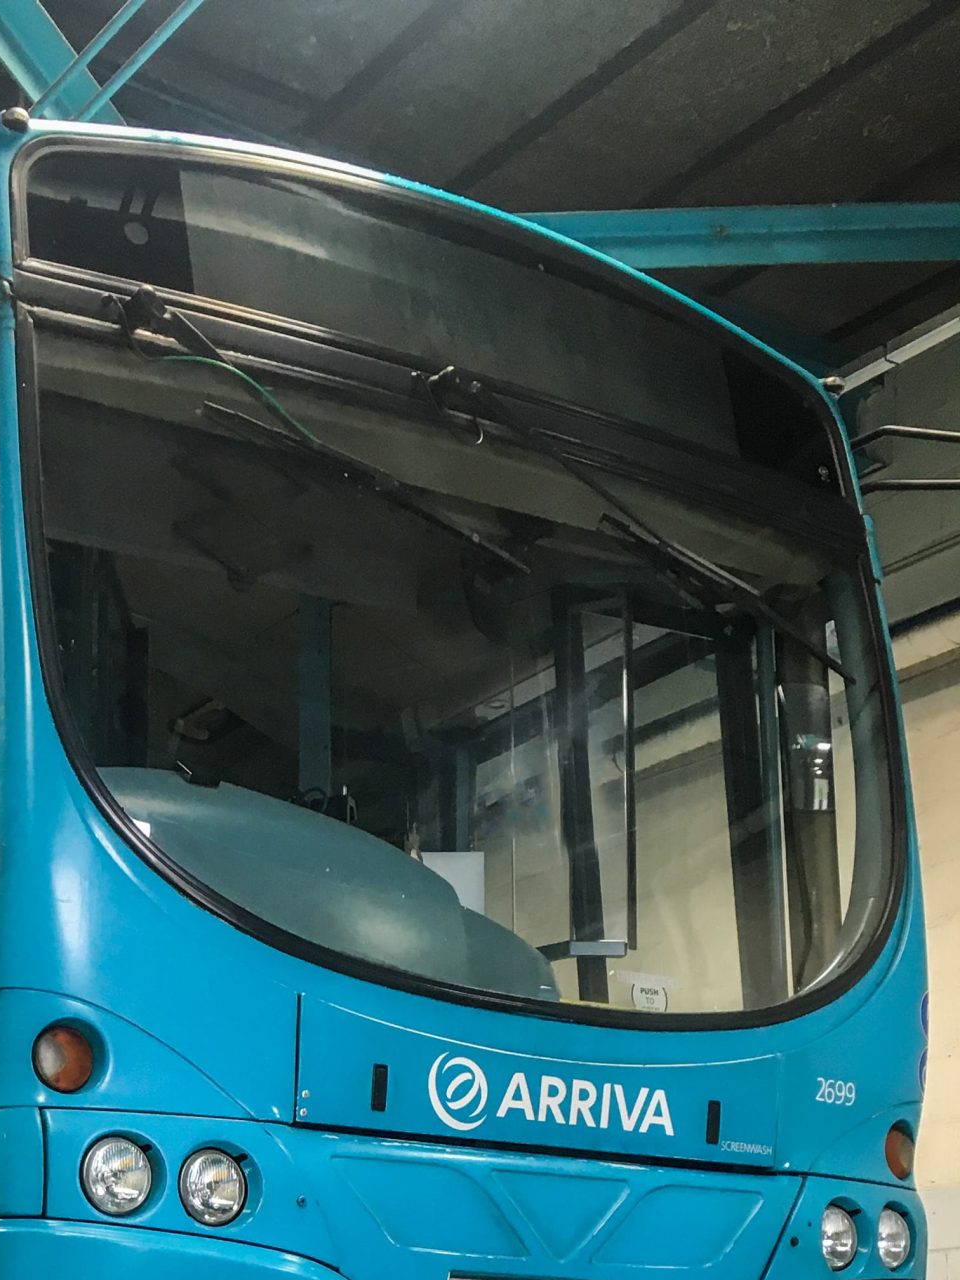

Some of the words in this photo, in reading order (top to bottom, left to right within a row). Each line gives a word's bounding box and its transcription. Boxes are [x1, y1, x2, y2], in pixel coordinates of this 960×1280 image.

[640, 987, 659, 996] PUSH
[645, 997, 655, 1005] TO
[815, 1077, 855, 1106] 2699
[496, 1072, 675, 1136] ARRIVA
[720, 1141, 773, 1155] SCREENWASH
